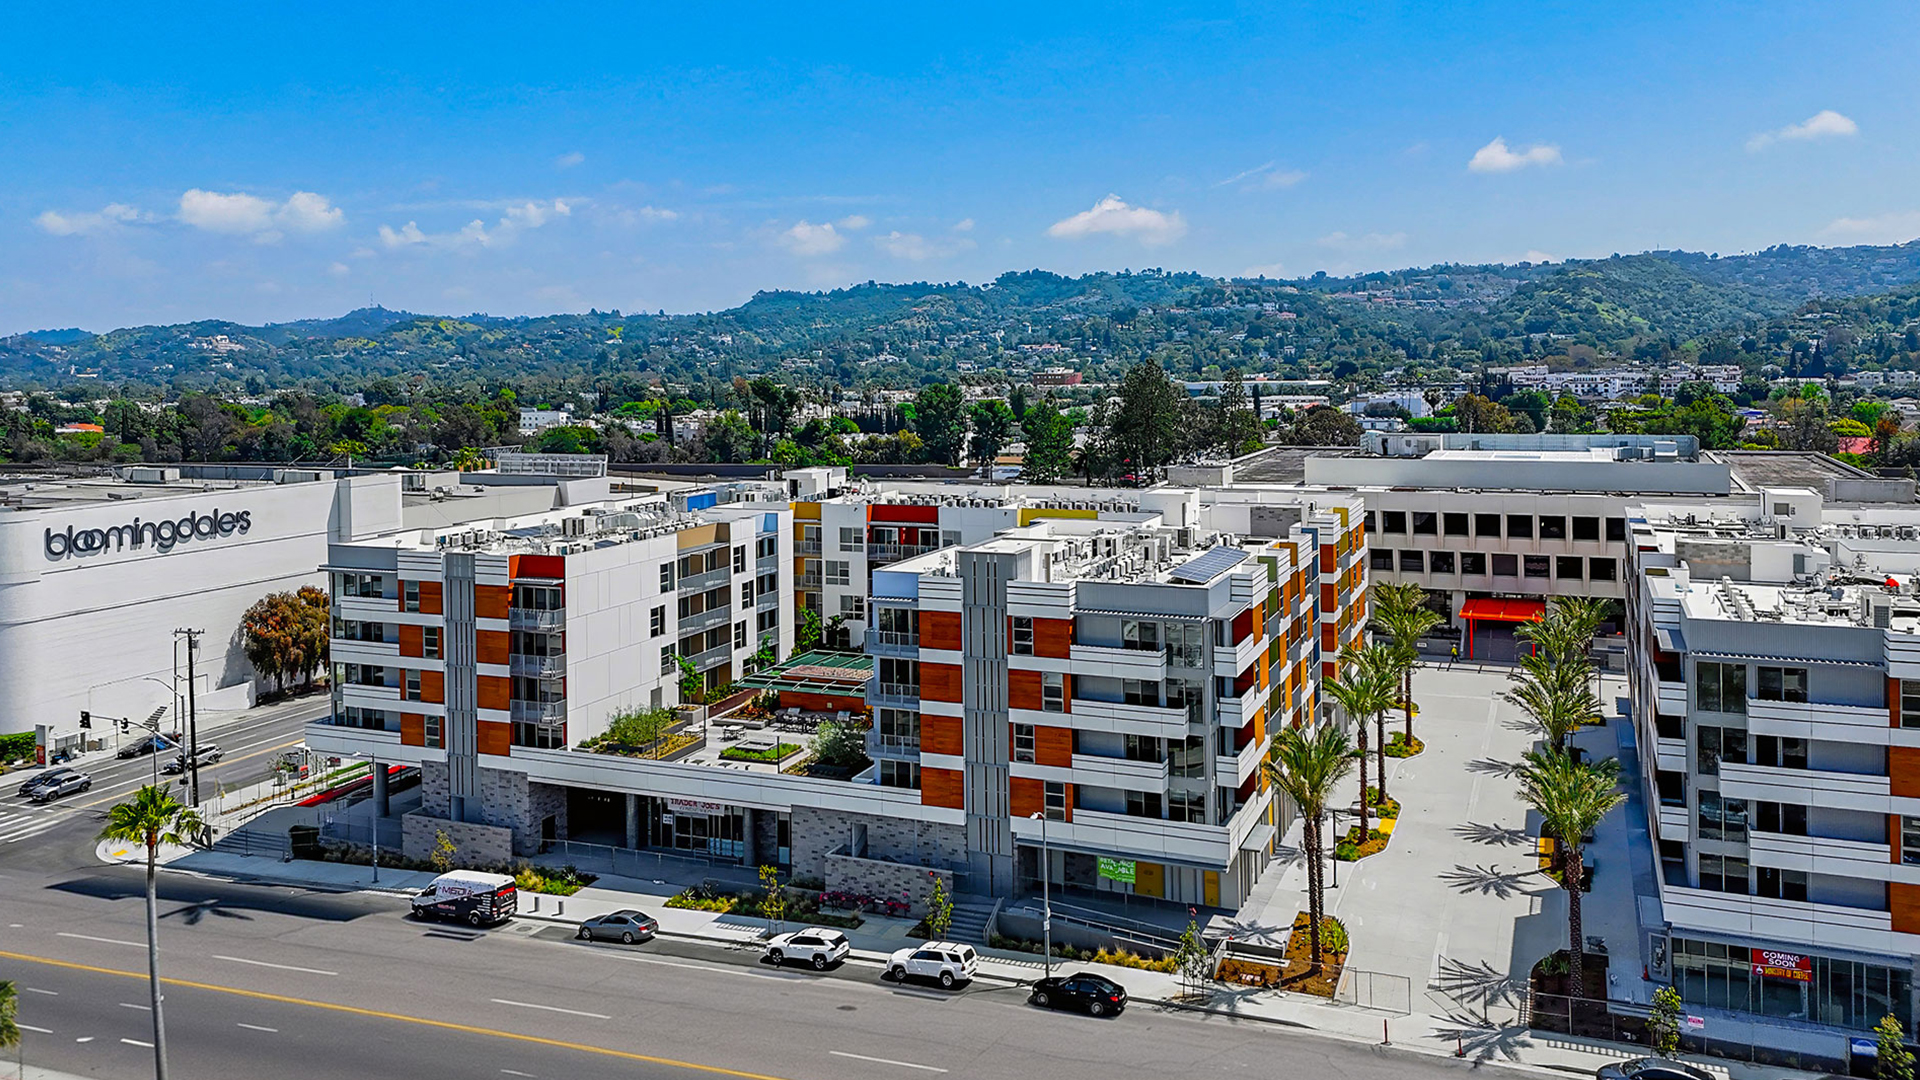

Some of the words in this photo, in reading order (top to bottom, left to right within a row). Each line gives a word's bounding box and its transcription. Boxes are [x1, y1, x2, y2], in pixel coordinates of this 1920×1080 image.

[45, 508, 251, 556] bloomingdale's
[671, 798, 698, 808] TRADER
[1100, 863, 1135, 875] AVALABLE
[1763, 951, 1800, 963] COMING
[1768, 958, 1796, 968] SOON
